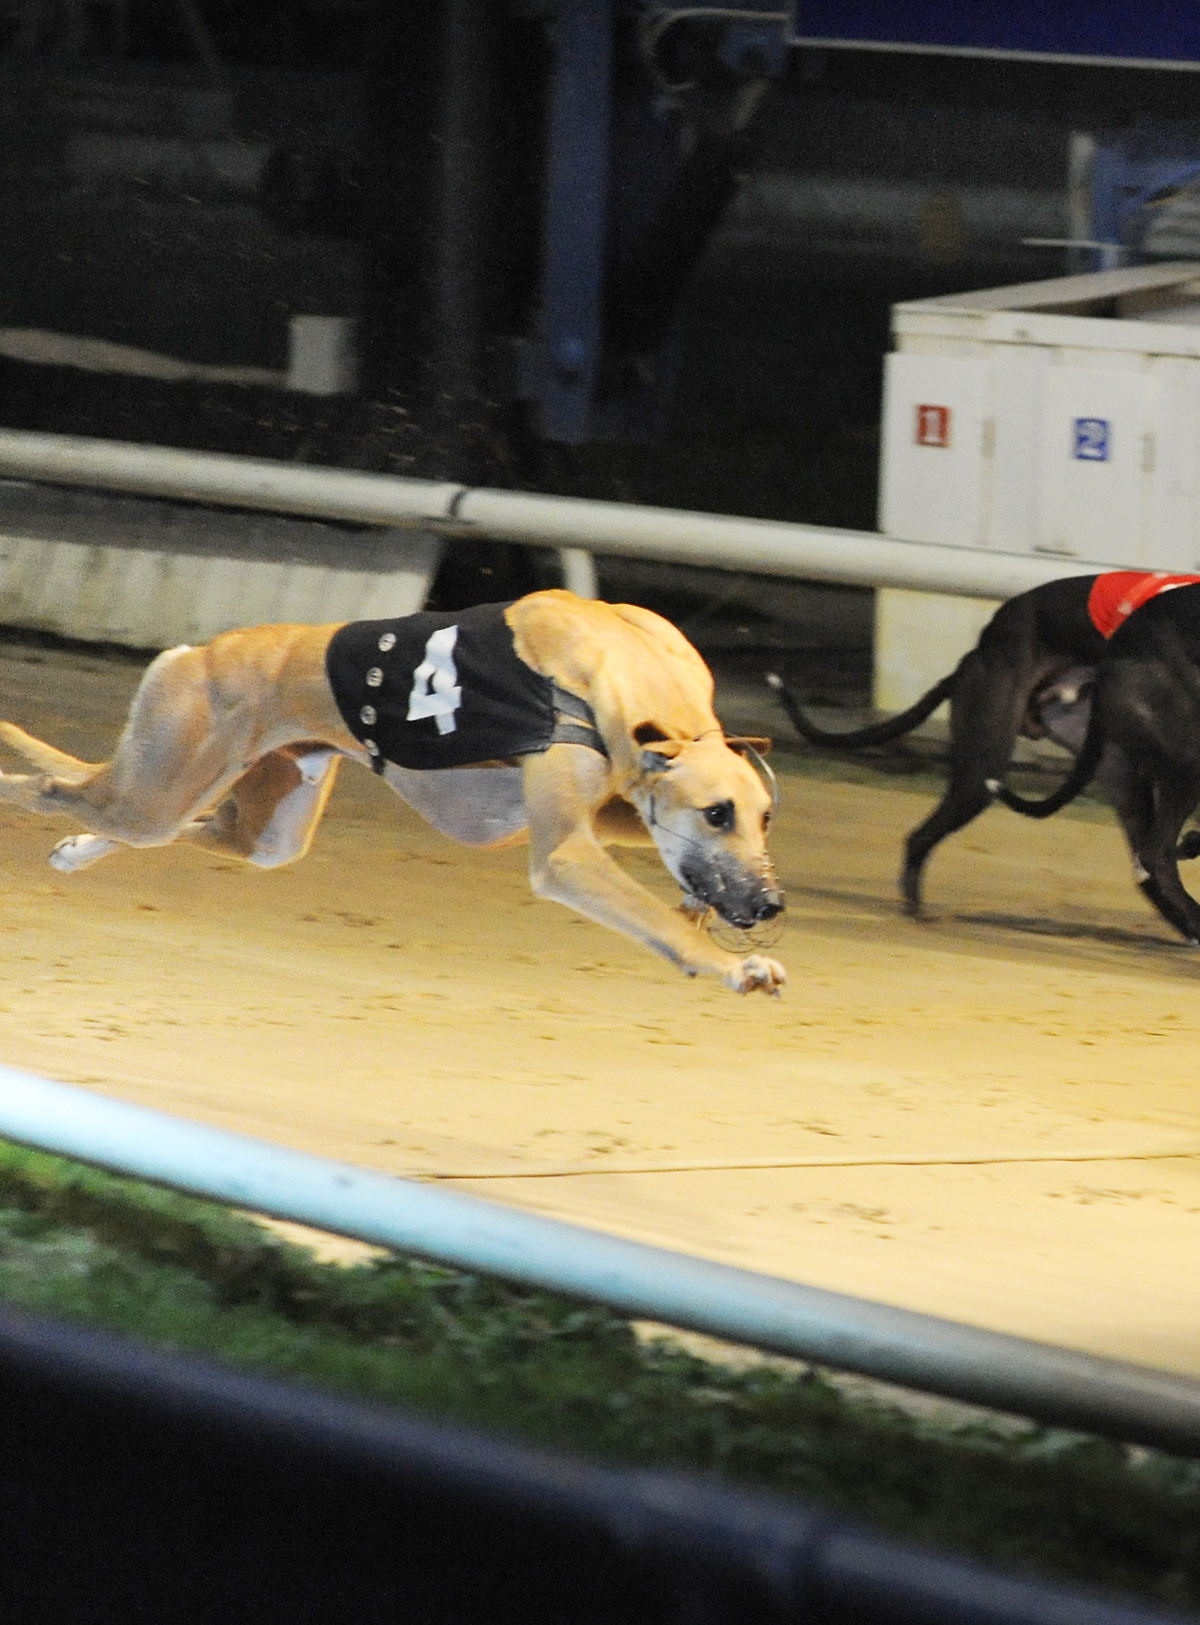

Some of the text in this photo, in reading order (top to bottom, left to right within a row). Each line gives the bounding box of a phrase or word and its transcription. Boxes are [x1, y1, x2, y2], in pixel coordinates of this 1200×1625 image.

[923, 409, 943, 444] 1
[1077, 421, 1106, 458] 2
[406, 624, 462, 735] 4
